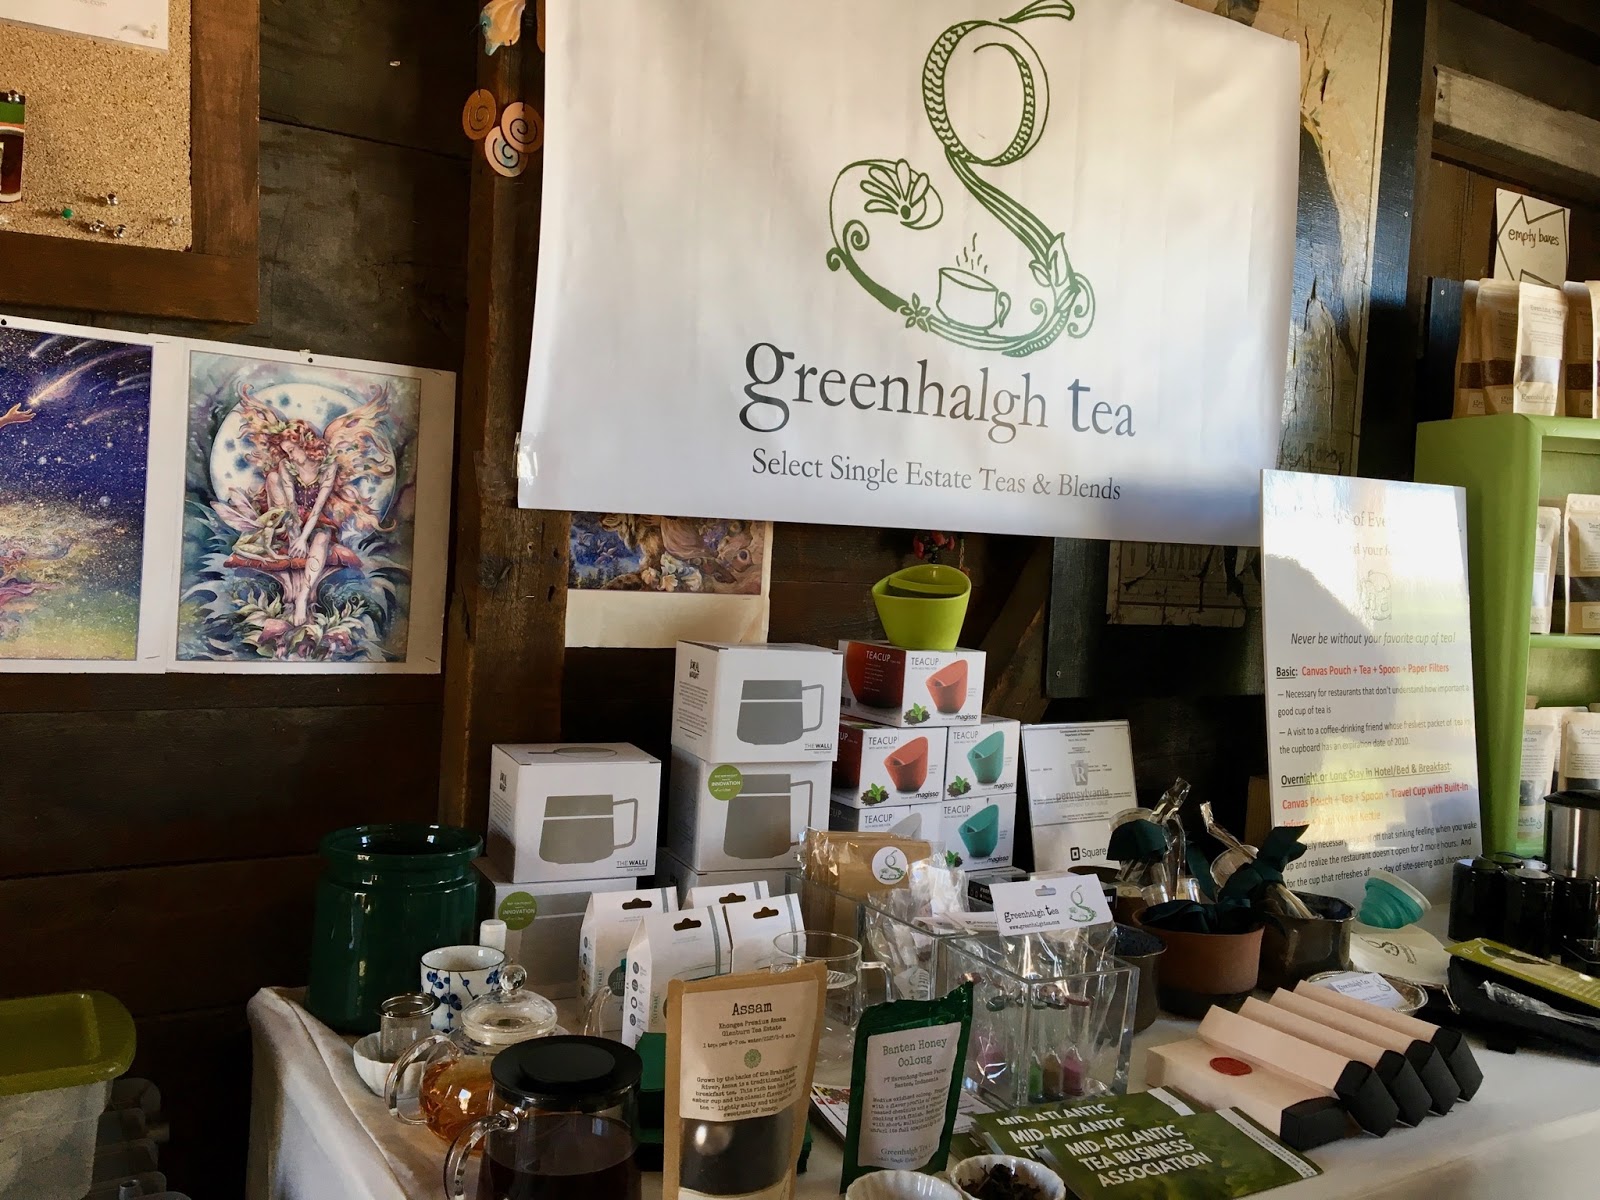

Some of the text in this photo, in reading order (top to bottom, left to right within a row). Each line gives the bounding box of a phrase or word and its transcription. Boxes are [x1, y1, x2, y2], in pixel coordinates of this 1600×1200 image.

[1508, 228, 1536, 248] empty
[739, 342, 1136, 444] greenhalgh tea
[752, 448, 1121, 500] Select Single Estate Teas & Blends
[1291, 633, 1316, 645] Never
[1318, 632, 1328, 644] be
[1330, 632, 1362, 644] without
[1364, 635, 1382, 646] your
[1383, 632, 1414, 646] favorite
[1416, 636, 1429, 646] cup
[1430, 632, 1439, 646] of
[866, 651, 891, 663] TEACUP
[911, 657, 940, 666] TEACUP
[1276, 663, 1450, 678] Basic: Canvas Pouch Tea Spoon Paper Filters
[1286, 690, 1317, 700] Necessary
[1318, 689, 1327, 698] for
[1328, 687, 1362, 697] restaurants
[1362, 686, 1375, 695] that
[1376, 686, 1391, 695] don't
[1392, 685, 1424, 694] understand
[1425, 685, 1437, 693] how
[955, 712, 978, 722] magisso
[1278, 706, 1332, 717] good cup of tea is
[954, 731, 979, 740] TEACUP
[1287, 728, 1293, 736] A
[1294, 727, 1306, 736] visit
[1307, 728, 1314, 736] to
[1320, 724, 1365, 735] coffee-drinking
[1366, 722, 1383, 732] friend
[1384, 722, 1403, 730] whose
[868, 736, 898, 746] TEACUP
[1280, 746, 1290, 755] the
[1292, 742, 1320, 754] cupboard
[1322, 742, 1333, 751] has
[1372, 738, 1386, 748] date
[1387, 738, 1394, 747] of
[1394, 737, 1410, 746] 2010.
[1281, 762, 1452, 786] Overnight or Long Stay in Hotel/Bed & Breakfast:
[994, 782, 1014, 790] magisso
[916, 792, 940, 800] magisso
[1056, 787, 1110, 801] pennsylvania
[1282, 782, 1469, 810] Canvas Pouch Tea Spoon Travel Cup with Built-In
[944, 805, 971, 815] TEACUP
[864, 813, 893, 824] TEACUP
[1318, 840, 1347, 849] necessary
[1382, 832, 1394, 840] that
[1396, 830, 1415, 839] sinking
[1416, 826, 1435, 836] feeling
[1436, 824, 1451, 834] when
[1452, 824, 1462, 833] you
[1463, 821, 1477, 830] wake
[987, 855, 1010, 864] magisso
[1082, 846, 1107, 860] Square
[1286, 837, 1472, 871] up and realize the restaurant doesn't open for 2 more hours. And
[1286, 878, 1296, 888] for
[1297, 878, 1307, 887] the
[1308, 876, 1320, 886] cup
[1322, 874, 1334, 884] that
[1335, 870, 1363, 882] refreshes
[1384, 865, 1394, 873] day
[1395, 863, 1402, 872] of
[1402, 859, 1433, 871] site-seeing
[1434, 857, 1444, 866] and
[1004, 904, 1060, 923] greenhalgh tea
[732, 1002, 773, 1016] Assam
[882, 1038, 948, 1056] Banten Honey
[898, 1055, 933, 1068] Oolong
[750, 1076, 783, 1085] traditional
[1008, 1118, 1126, 1144] MID-ATLANTIC
[1064, 1124, 1184, 1157] MID-ATLANTIC
[1078, 1138, 1195, 1172] TEA BUSINESS
[1097, 1151, 1213, 1188] ASSOCIATION
